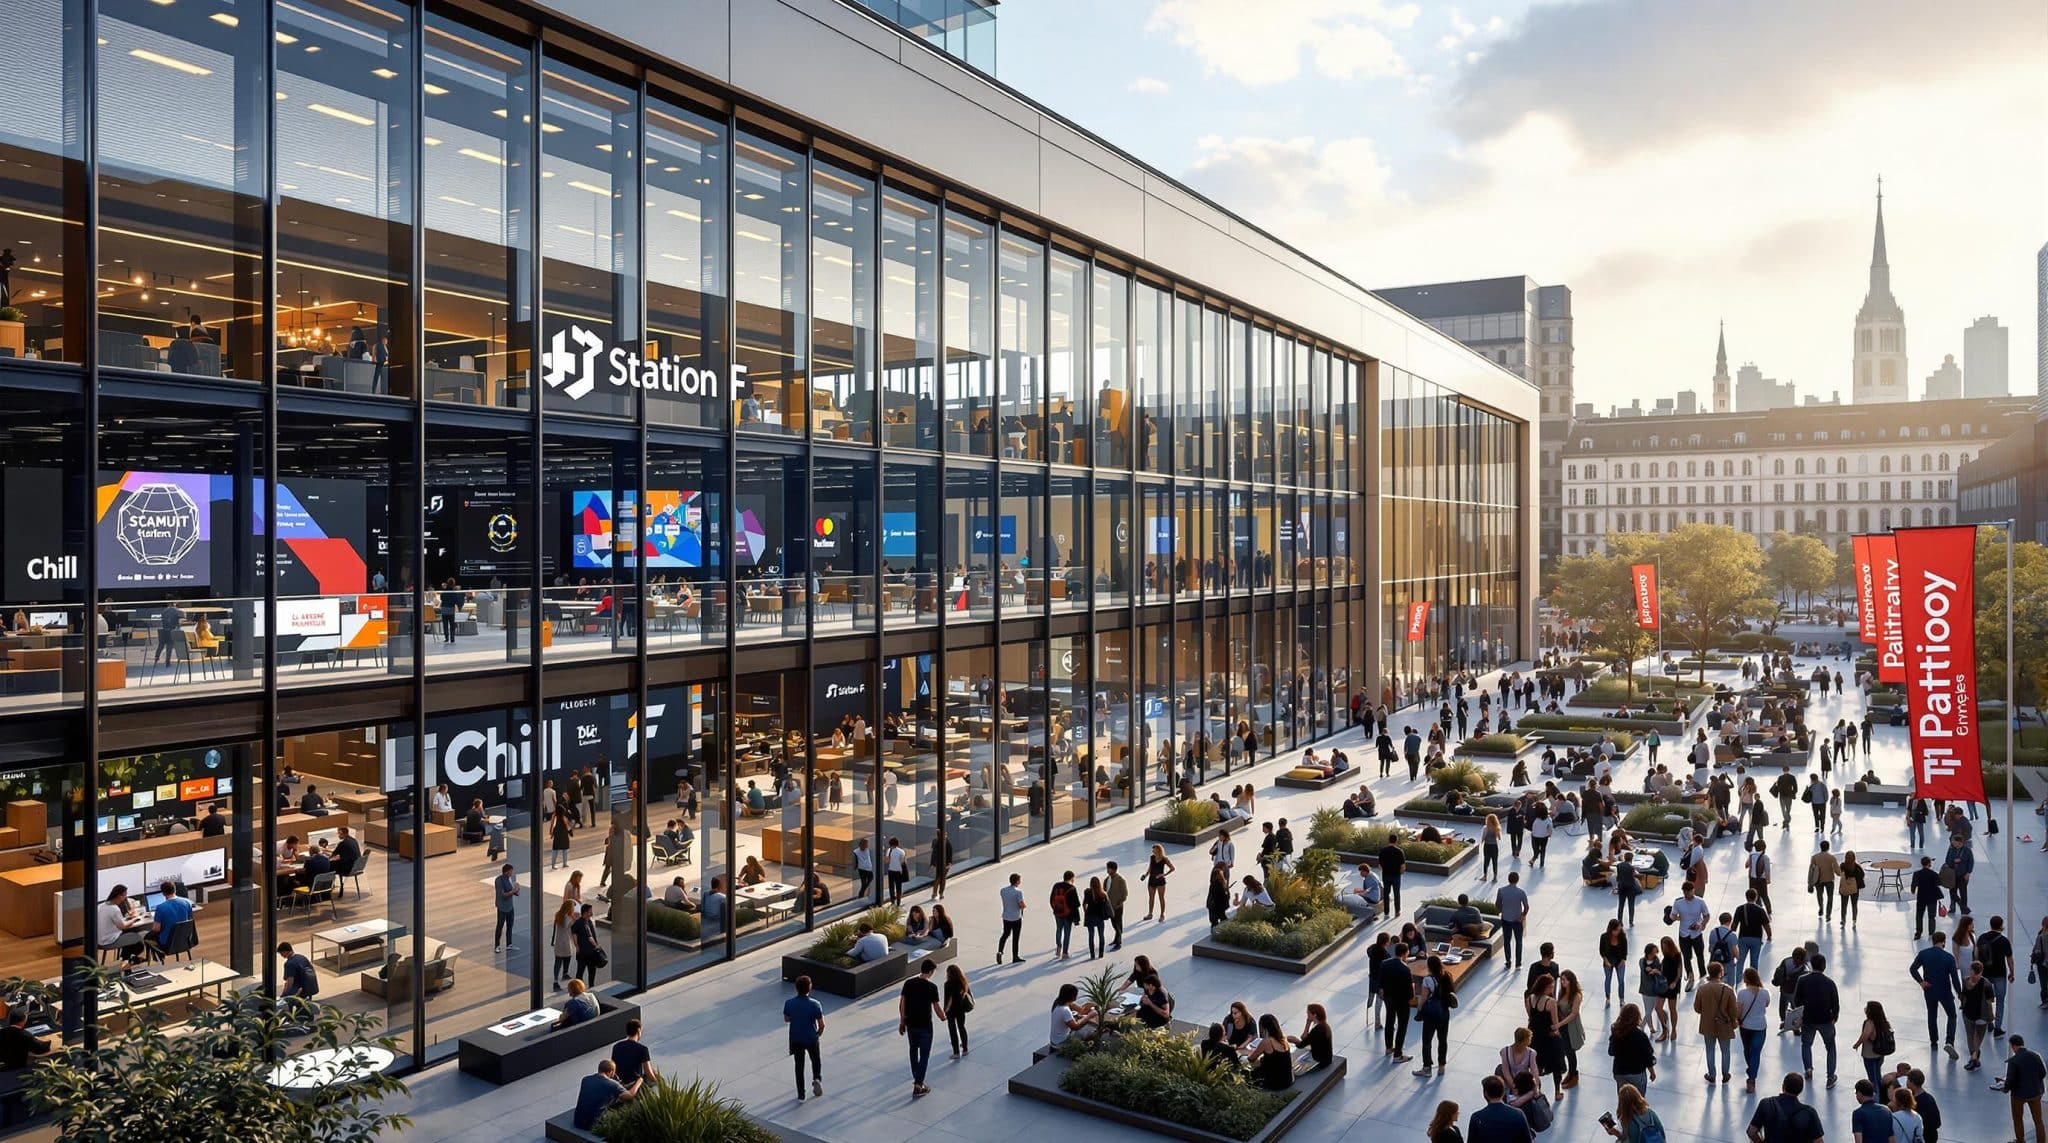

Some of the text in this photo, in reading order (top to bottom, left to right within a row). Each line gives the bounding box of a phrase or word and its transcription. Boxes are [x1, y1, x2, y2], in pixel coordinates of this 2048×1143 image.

[609, 347, 747, 401] Station F
[27, 555, 77, 580] Chill
[444, 718, 562, 787] Chill
